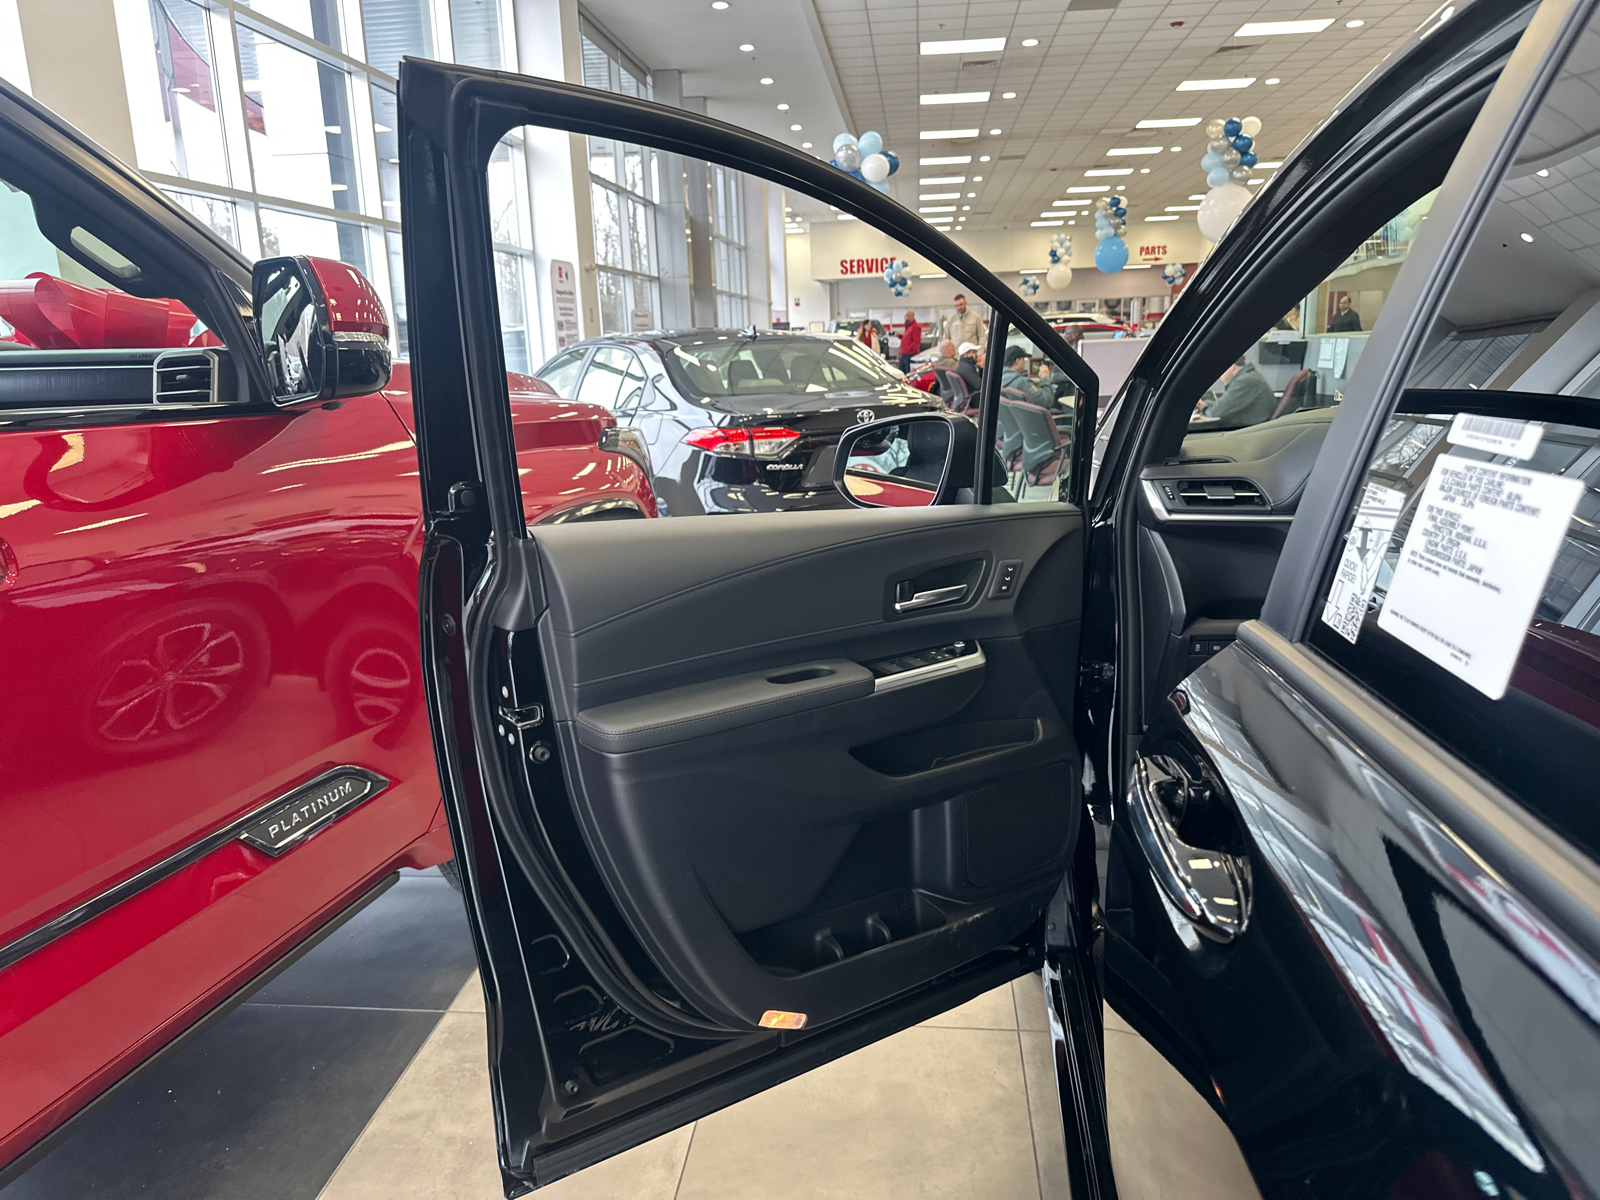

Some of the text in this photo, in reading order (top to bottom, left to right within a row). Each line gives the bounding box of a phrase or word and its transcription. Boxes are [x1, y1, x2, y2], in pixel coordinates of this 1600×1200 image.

[1139, 245, 1167, 256] PARTS
[840, 257, 896, 275] SERVIC
[268, 781, 353, 839] PLATINUM
